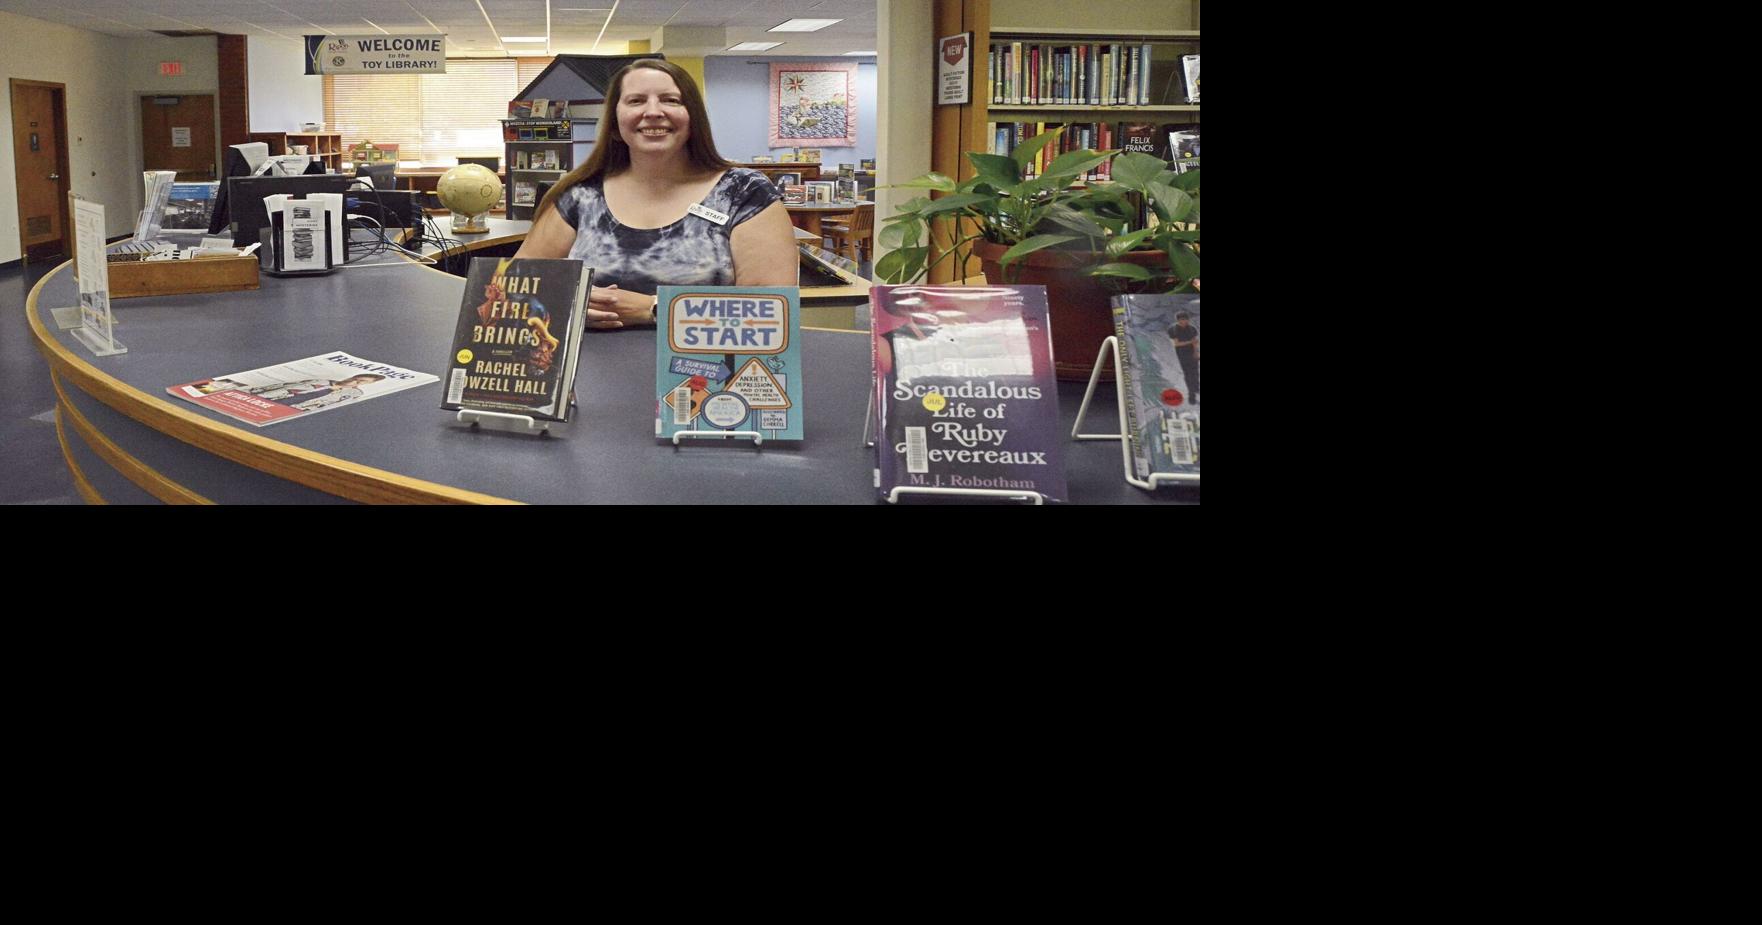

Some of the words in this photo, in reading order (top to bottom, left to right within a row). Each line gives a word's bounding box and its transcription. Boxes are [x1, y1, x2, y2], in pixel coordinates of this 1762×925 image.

[357, 38, 441, 52] WELCOME
[947, 44, 962, 57] NEW
[362, 61, 382, 69] TOY
[385, 60, 437, 69] LIBRARY!
[1125, 144, 1154, 152] FRANCIS
[1129, 136, 1151, 144] FELIX
[704, 211, 725, 221] STAFF
[491, 276, 541, 295] WHAT
[684, 299, 775, 318] WHERE
[719, 318, 741, 328] TO
[1116, 320, 1125, 337] THE
[472, 325, 541, 347] BRINGS
[683, 327, 777, 346] START
[475, 360, 527, 377] RACHEL
[674, 366, 702, 376] GUIDE
[704, 371, 717, 379] TO
[684, 360, 721, 373] SURVIVAL
[941, 361, 989, 378] The
[463, 375, 510, 392] OWZELL
[514, 380, 548, 396] HALL
[893, 380, 1042, 401] Scandalous
[932, 402, 977, 419] Life
[983, 402, 1007, 419] of
[931, 421, 1008, 448] Ruby
[895, 442, 1048, 465] evereaux
[910, 473, 930, 486] M.
[933, 474, 946, 488] J.
[950, 474, 1035, 490] Robotham
